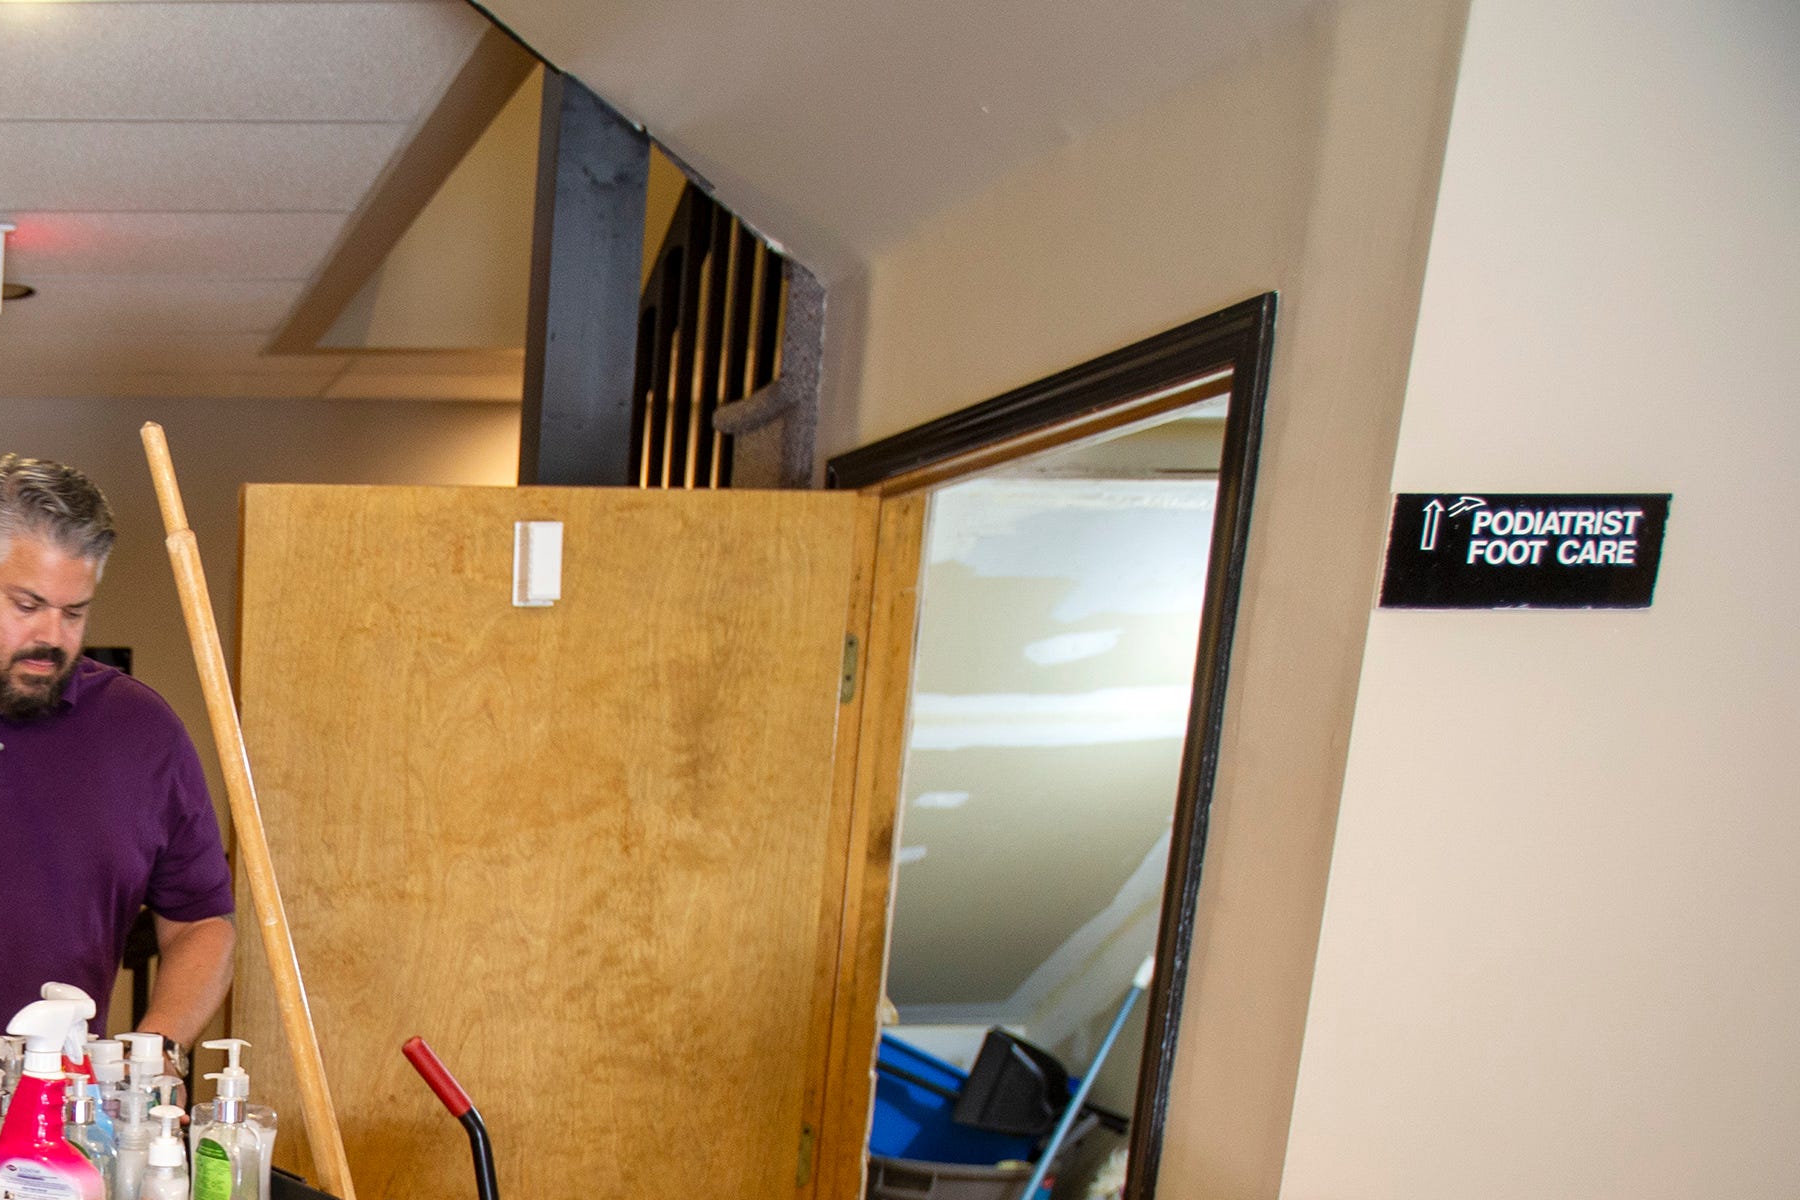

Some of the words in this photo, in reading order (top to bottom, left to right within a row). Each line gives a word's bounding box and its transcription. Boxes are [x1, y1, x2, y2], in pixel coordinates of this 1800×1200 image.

[1471, 510, 1643, 536] PODIATRIST
[1466, 540, 1548, 565] FOOT
[1556, 540, 1637, 565] CARE
